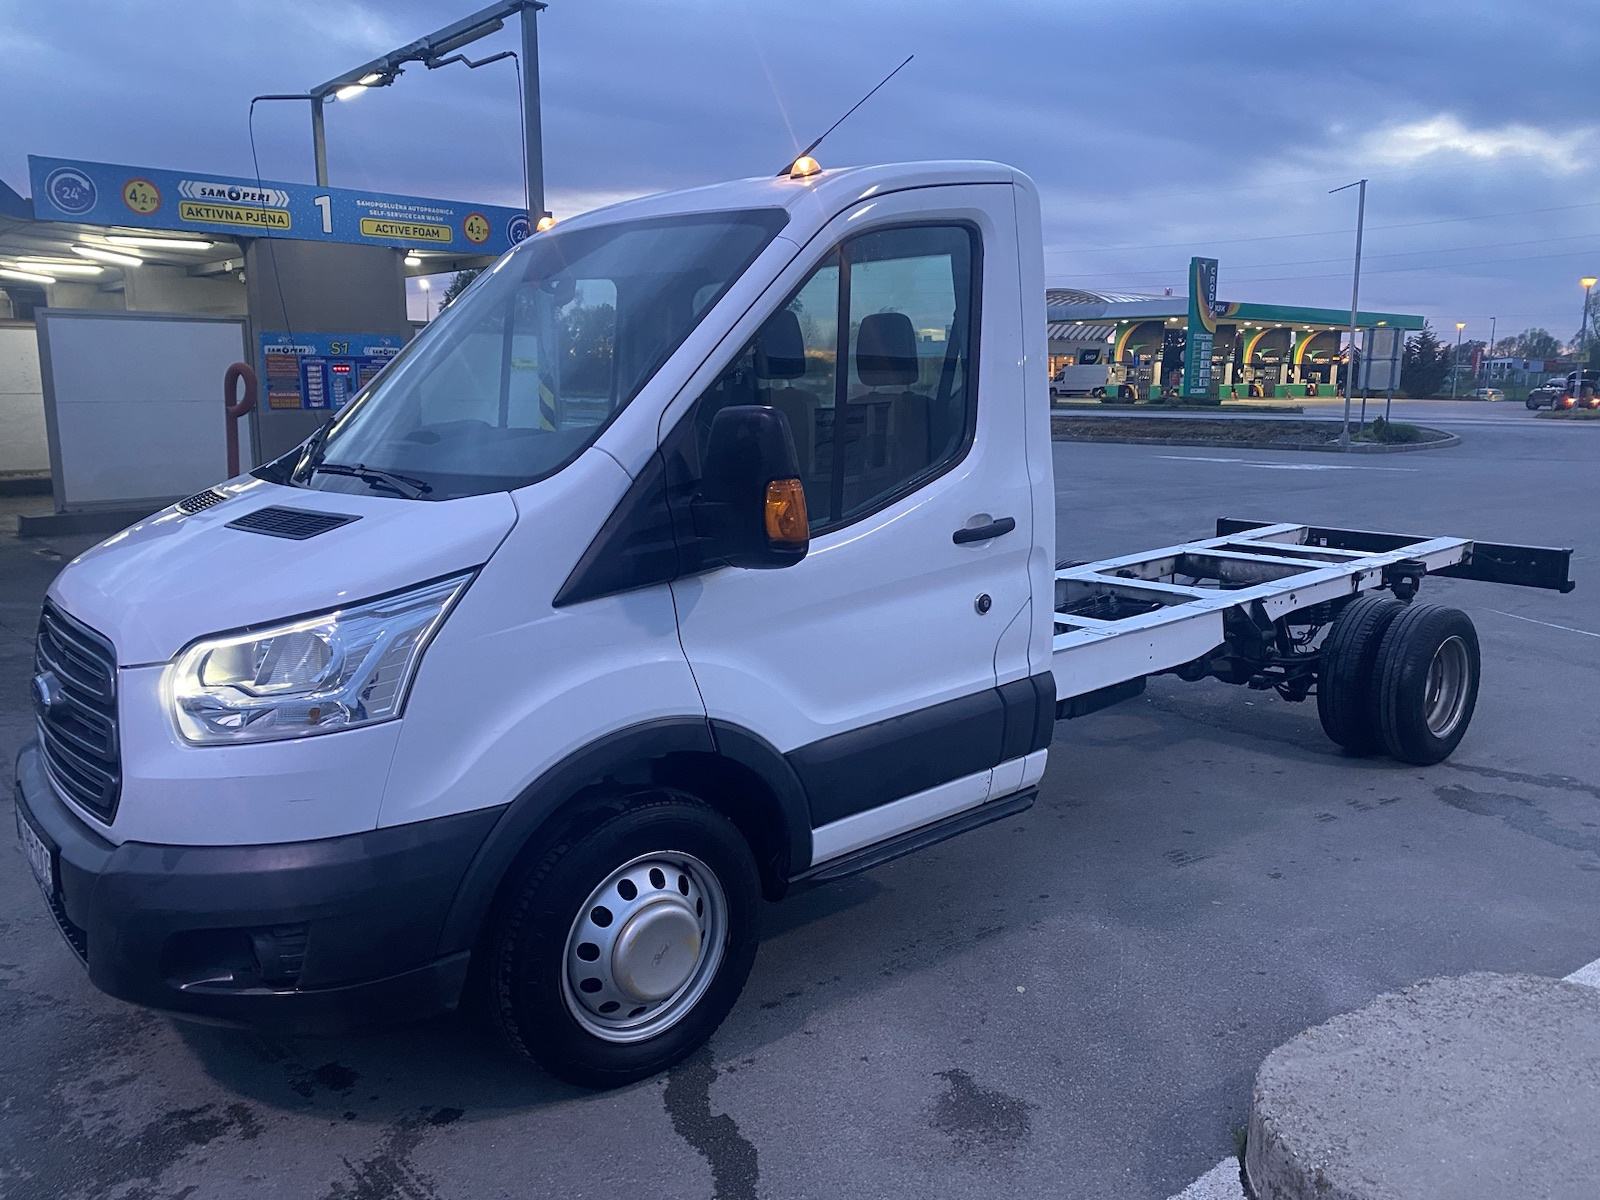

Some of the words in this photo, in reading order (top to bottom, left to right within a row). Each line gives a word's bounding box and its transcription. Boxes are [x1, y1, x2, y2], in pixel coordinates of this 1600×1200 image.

[200, 186, 270, 202] SAMOPERI
[186, 206, 243, 221] AKTIVNA
[246, 212, 285, 225] PJENA
[314, 195, 333, 233] 1
[369, 209, 412, 219] SELF-SERVICE
[375, 224, 411, 236] ACTIVE
[413, 226, 440, 238] FOAM
[331, 341, 348, 355] S1
